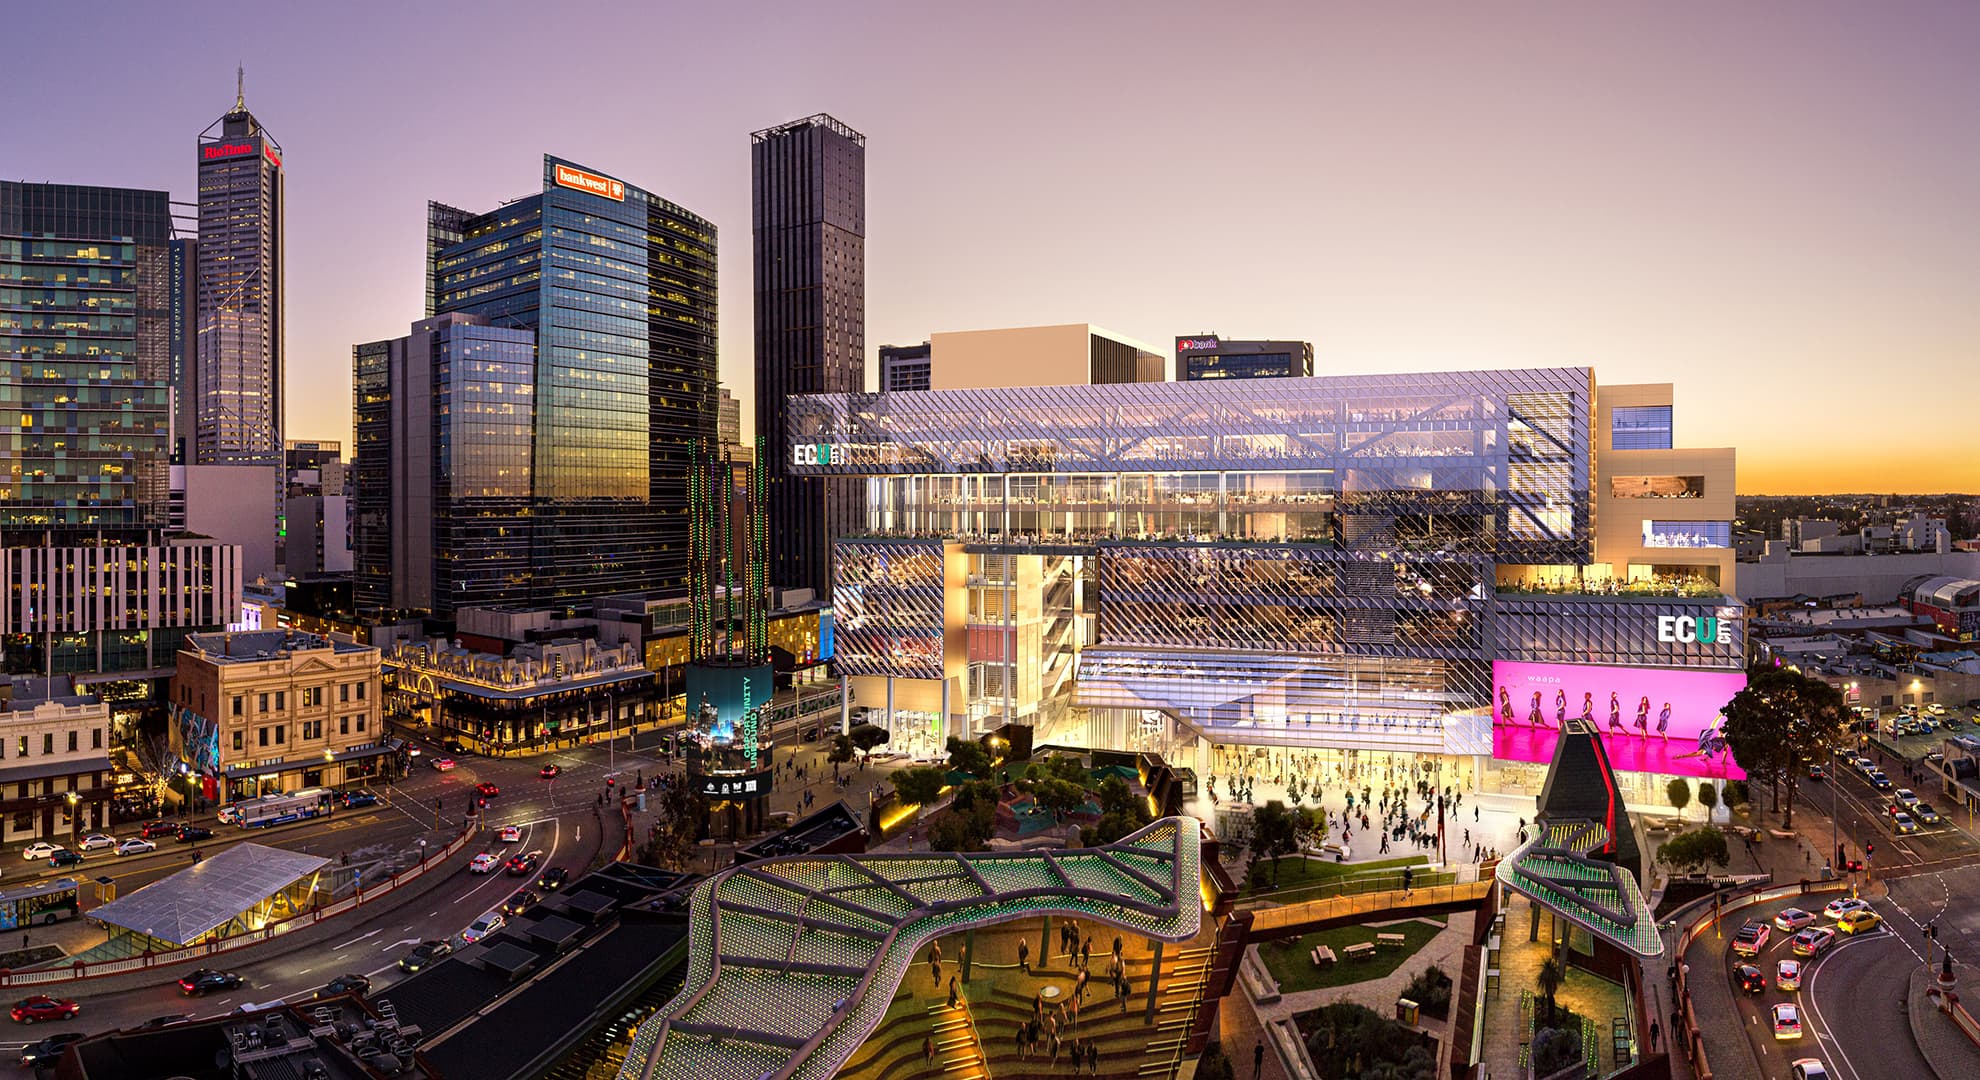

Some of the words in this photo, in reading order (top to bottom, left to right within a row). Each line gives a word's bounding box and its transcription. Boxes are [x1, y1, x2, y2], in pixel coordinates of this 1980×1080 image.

[560, 168, 607, 192] bankwest
[794, 443, 830, 466] ECU
[1658, 615, 1717, 644] ECU
[1717, 617, 1732, 645] CITY
[1527, 675, 1561, 684] waapa
[743, 676, 751, 759] OPPORTUNITY
[750, 712, 758, 769] UNBOUND
